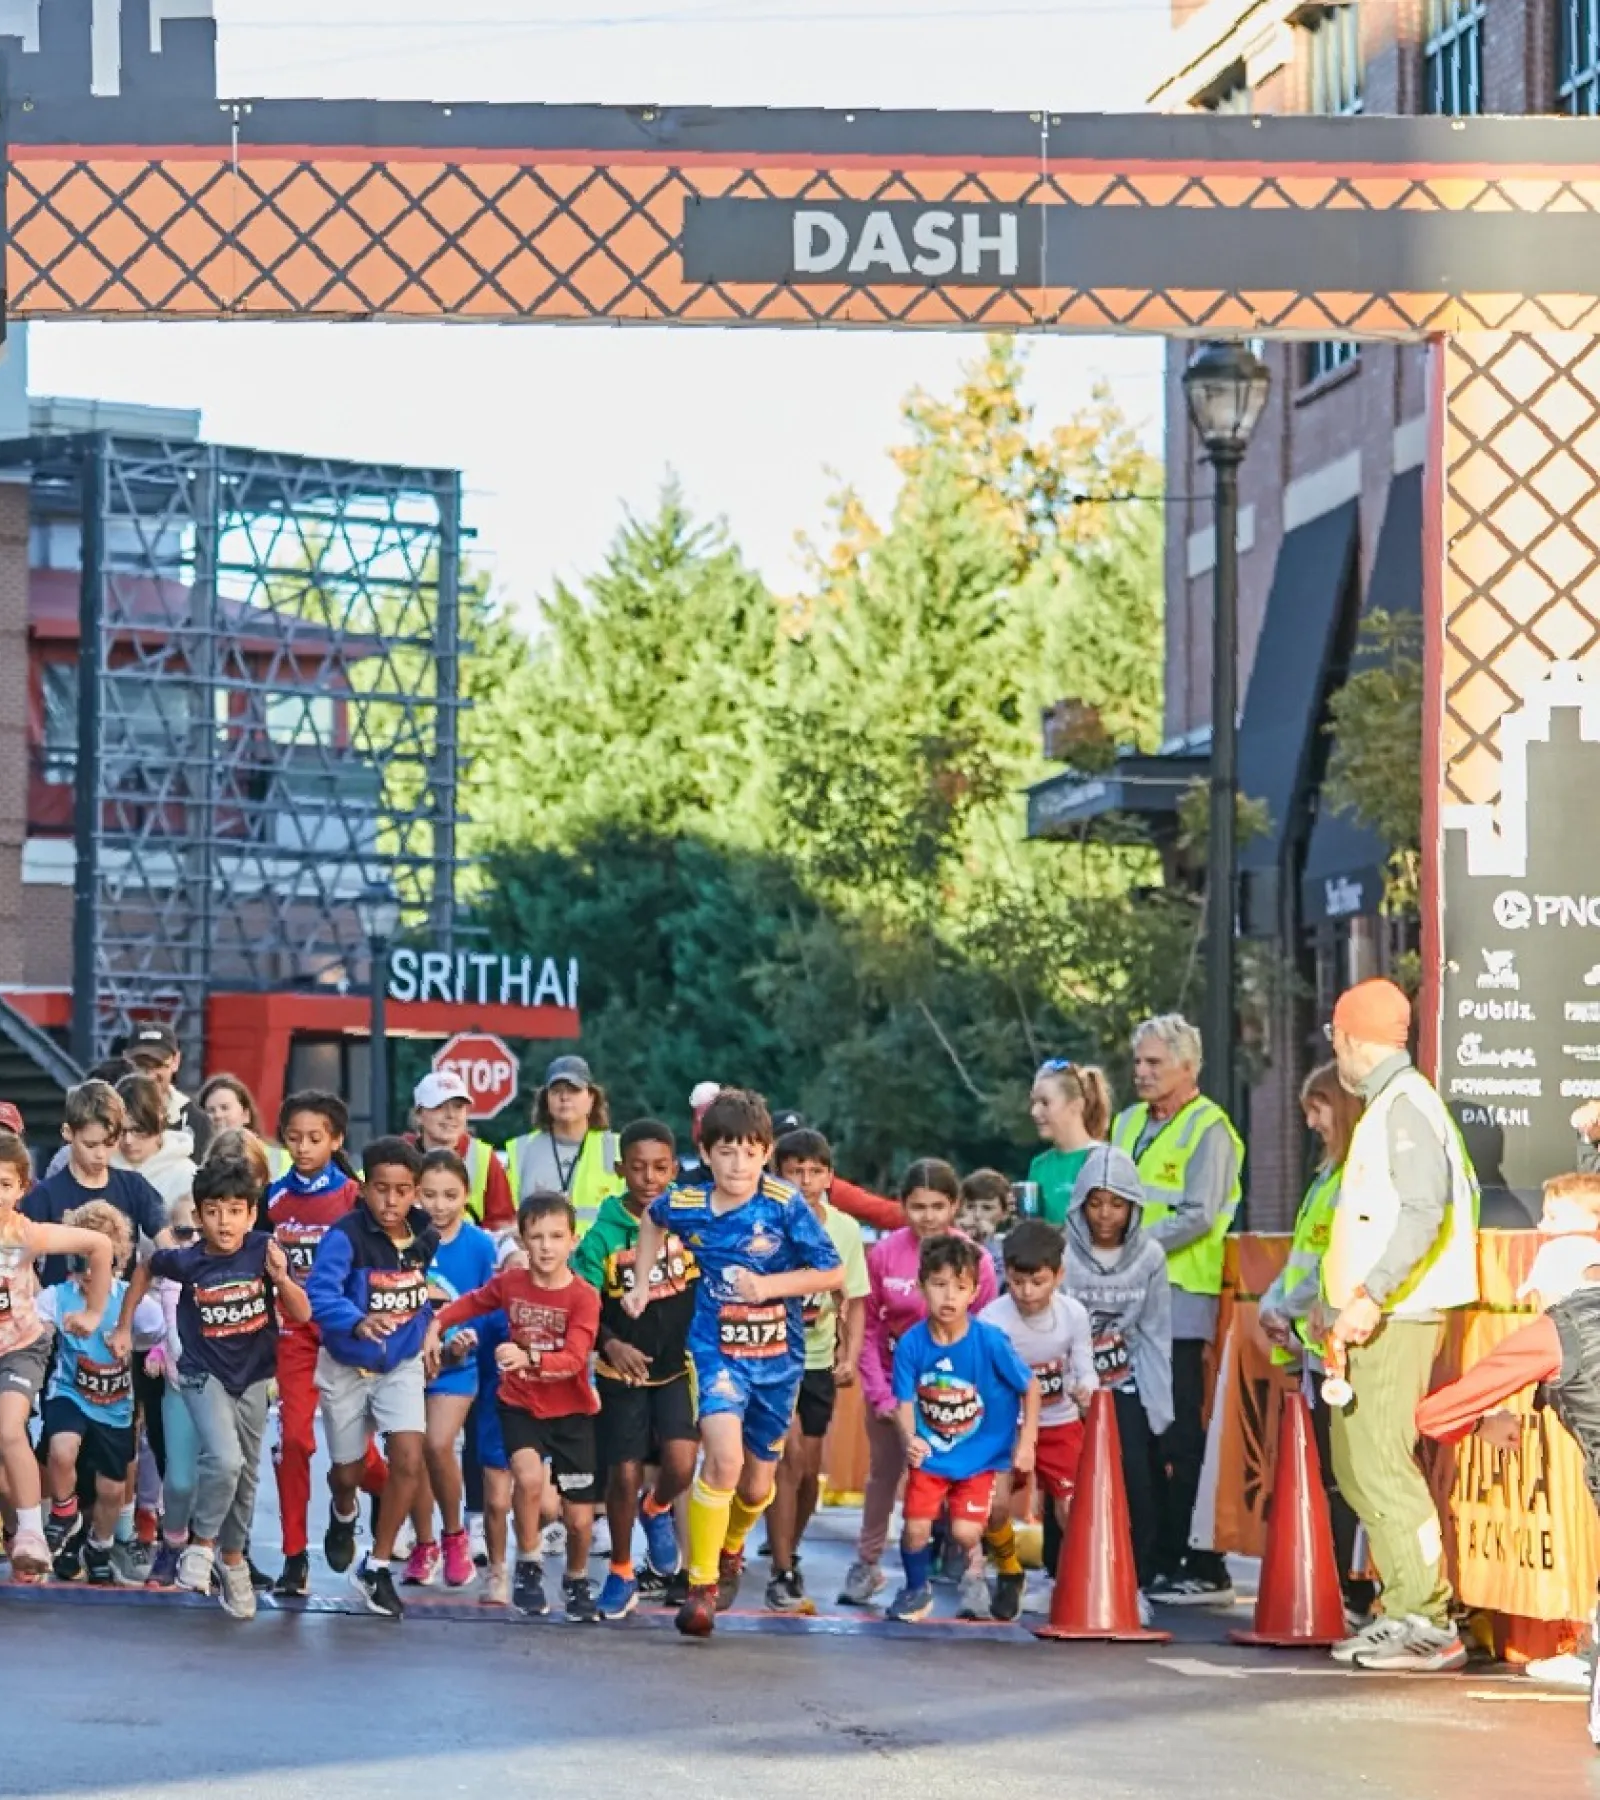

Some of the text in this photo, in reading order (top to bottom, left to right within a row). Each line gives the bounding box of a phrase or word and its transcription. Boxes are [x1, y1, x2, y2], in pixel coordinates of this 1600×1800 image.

[793, 210, 1019, 276] DASH
[388, 949, 579, 1010] SRITHAI
[200, 1297, 266, 1324] 39648
[370, 1286, 429, 1310] 39619
